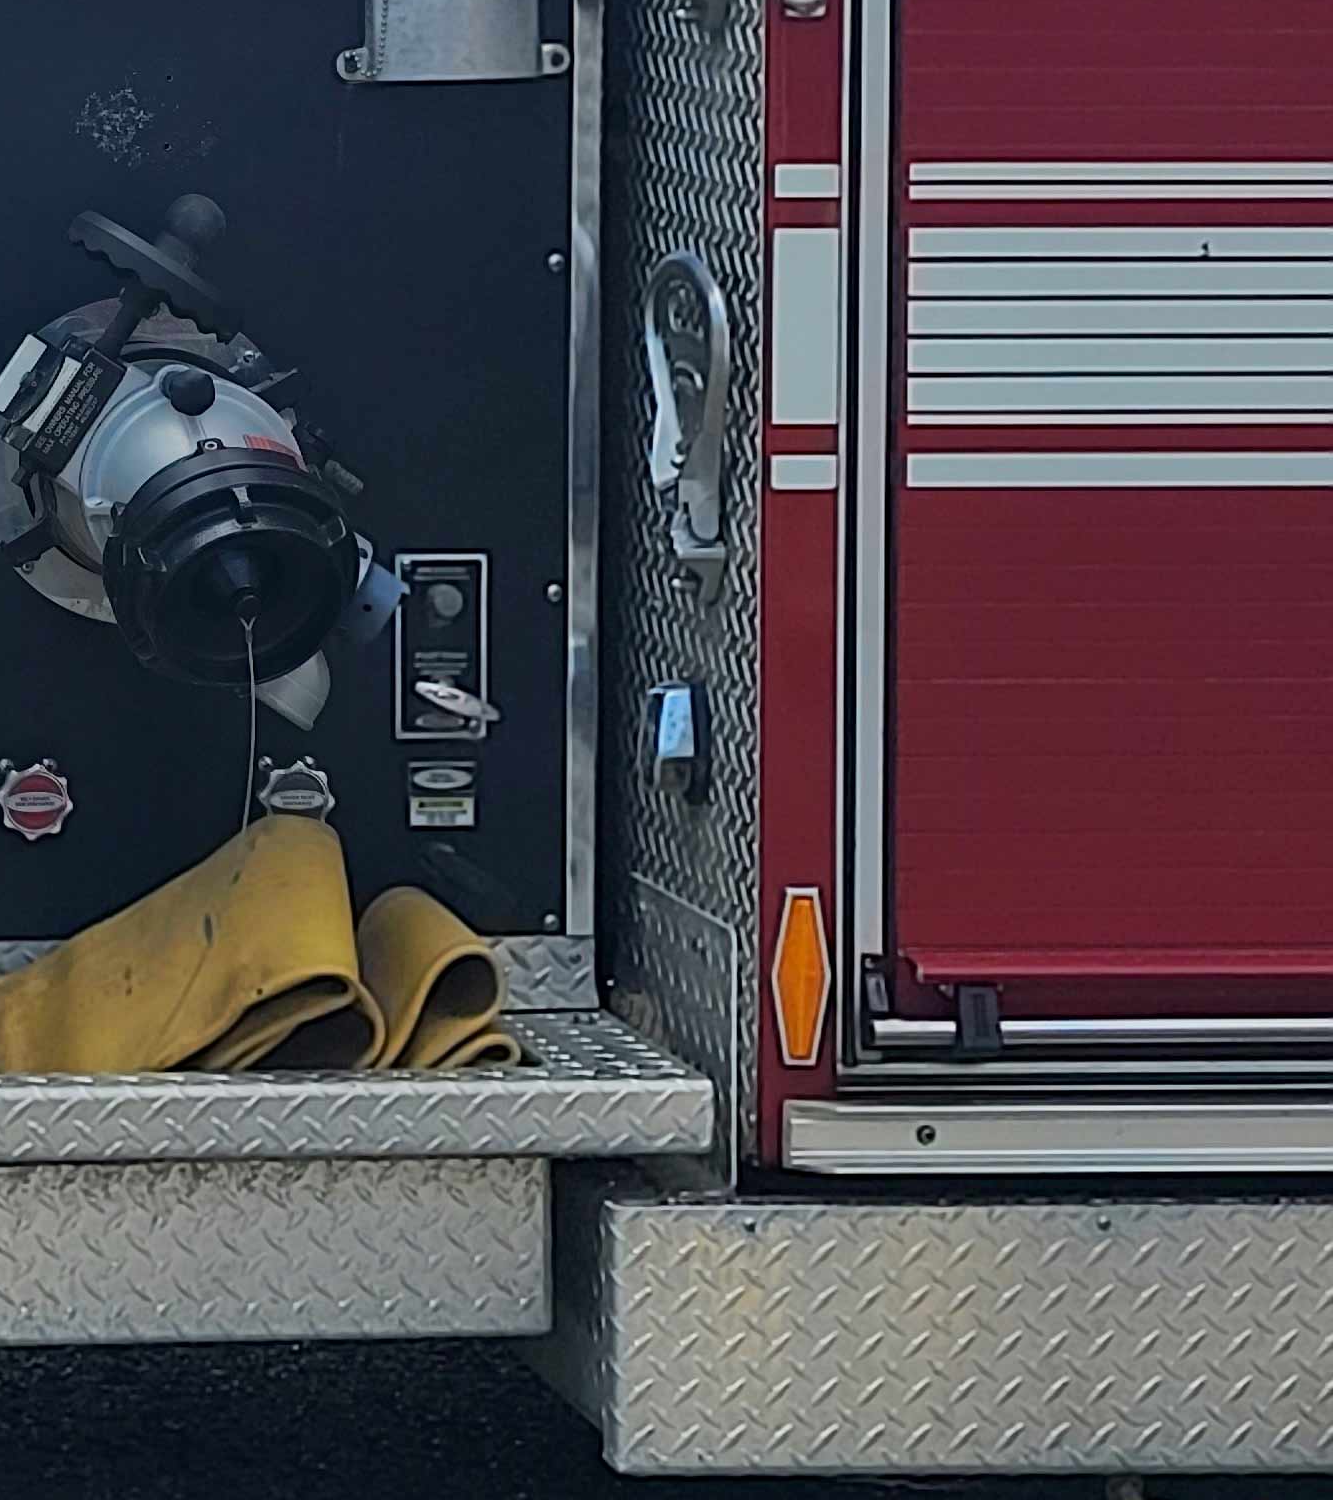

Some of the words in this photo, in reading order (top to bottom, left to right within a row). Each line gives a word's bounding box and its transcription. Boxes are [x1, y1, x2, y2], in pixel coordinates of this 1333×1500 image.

[34, 435, 48, 449] SEE
[64, 379, 86, 405] MANUAL
[82, 361, 96, 377] FOR
[53, 400, 81, 437] OPERATING
[77, 367, 104, 400] PRESSURE
